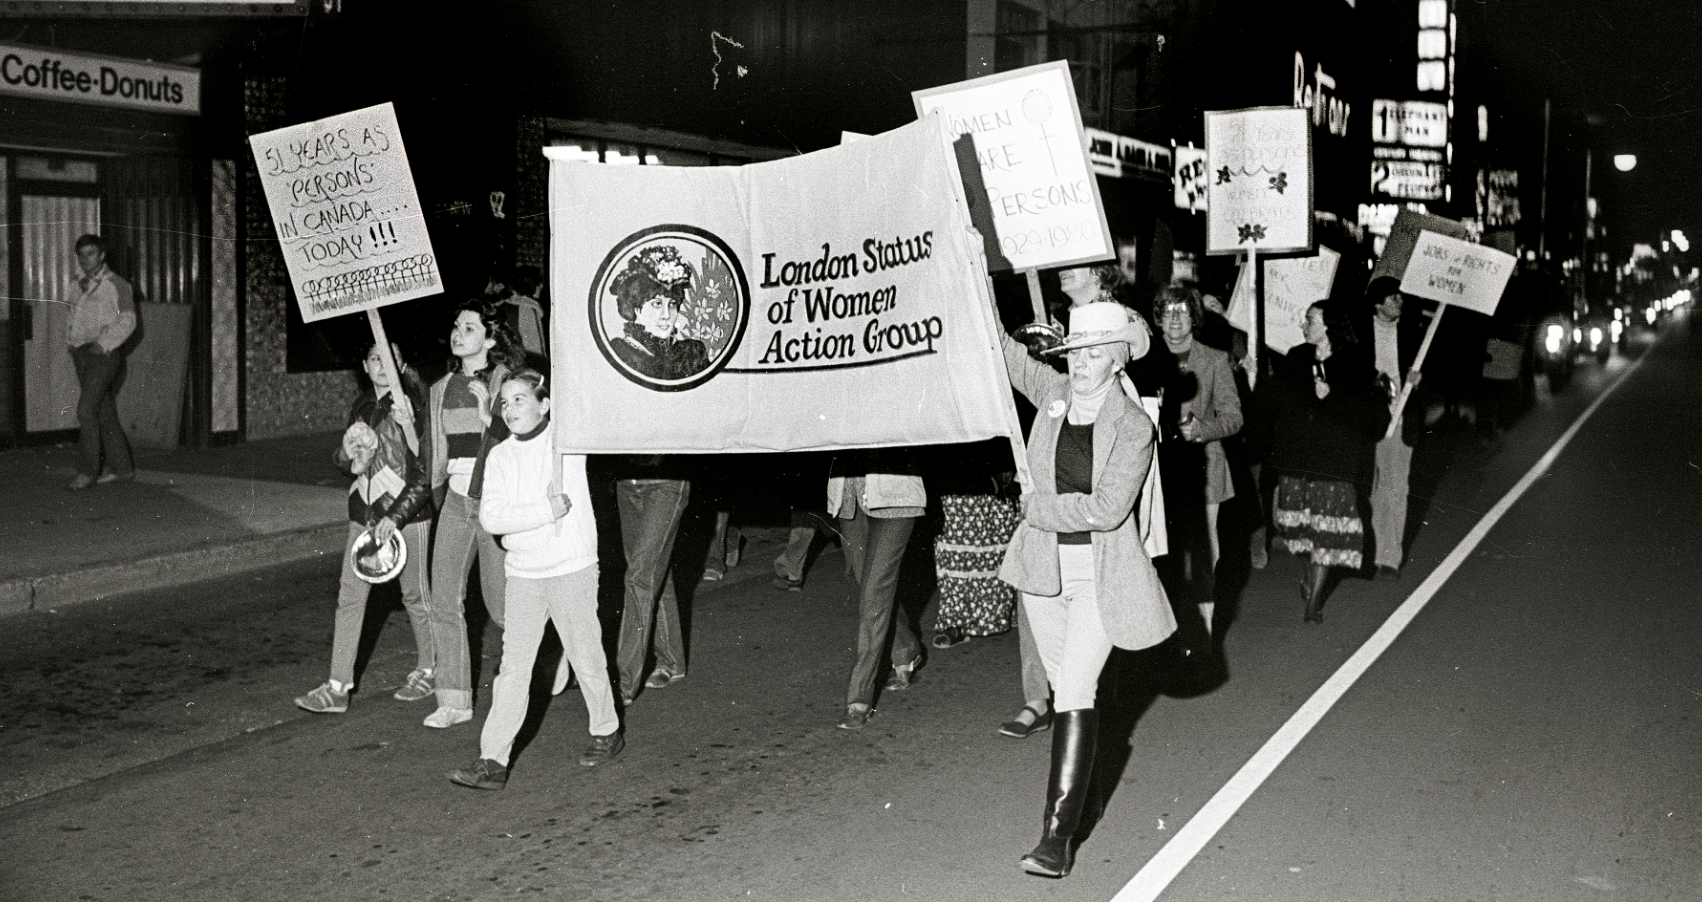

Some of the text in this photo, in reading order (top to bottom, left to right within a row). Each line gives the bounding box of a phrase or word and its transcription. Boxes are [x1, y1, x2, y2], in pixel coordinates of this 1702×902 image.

[265, 125, 390, 171] 51 YEARS AS
[977, 143, 1023, 172] ARE
[984, 179, 1092, 217] PERSONS
[279, 213, 298, 239] IN
[1001, 219, 1096, 256] 929-1980
[760, 230, 933, 289] London Status
[767, 284, 897, 324] of Women
[758, 316, 943, 364] Action Group
